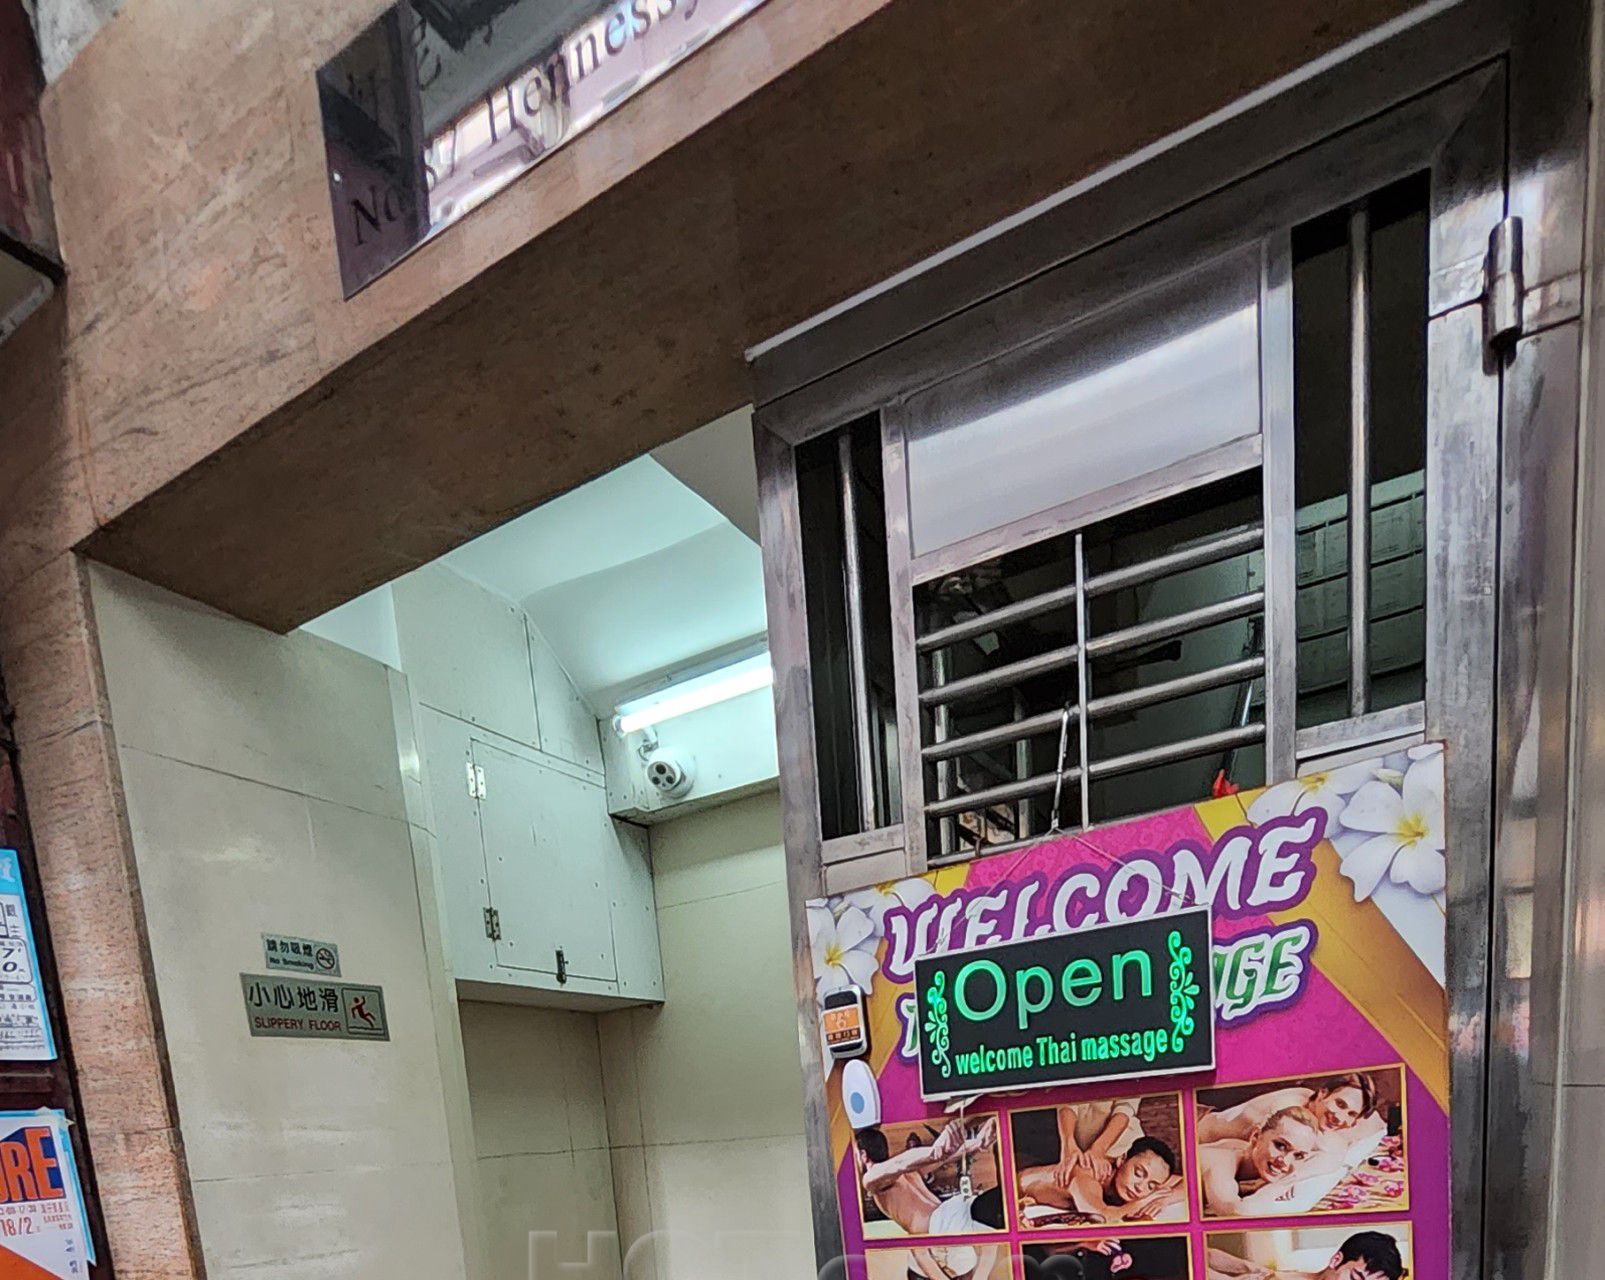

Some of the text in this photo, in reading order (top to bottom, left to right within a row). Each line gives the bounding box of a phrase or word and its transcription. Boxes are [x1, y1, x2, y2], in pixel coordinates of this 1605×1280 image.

[890, 818, 1318, 977] WELCOME
[249, 981, 339, 1013] 小心地滑
[954, 949, 1153, 1030] Open
[254, 1016, 342, 1032] SLIPPERY FLOOR
[955, 1027, 1169, 1076] welcome Thai massage
